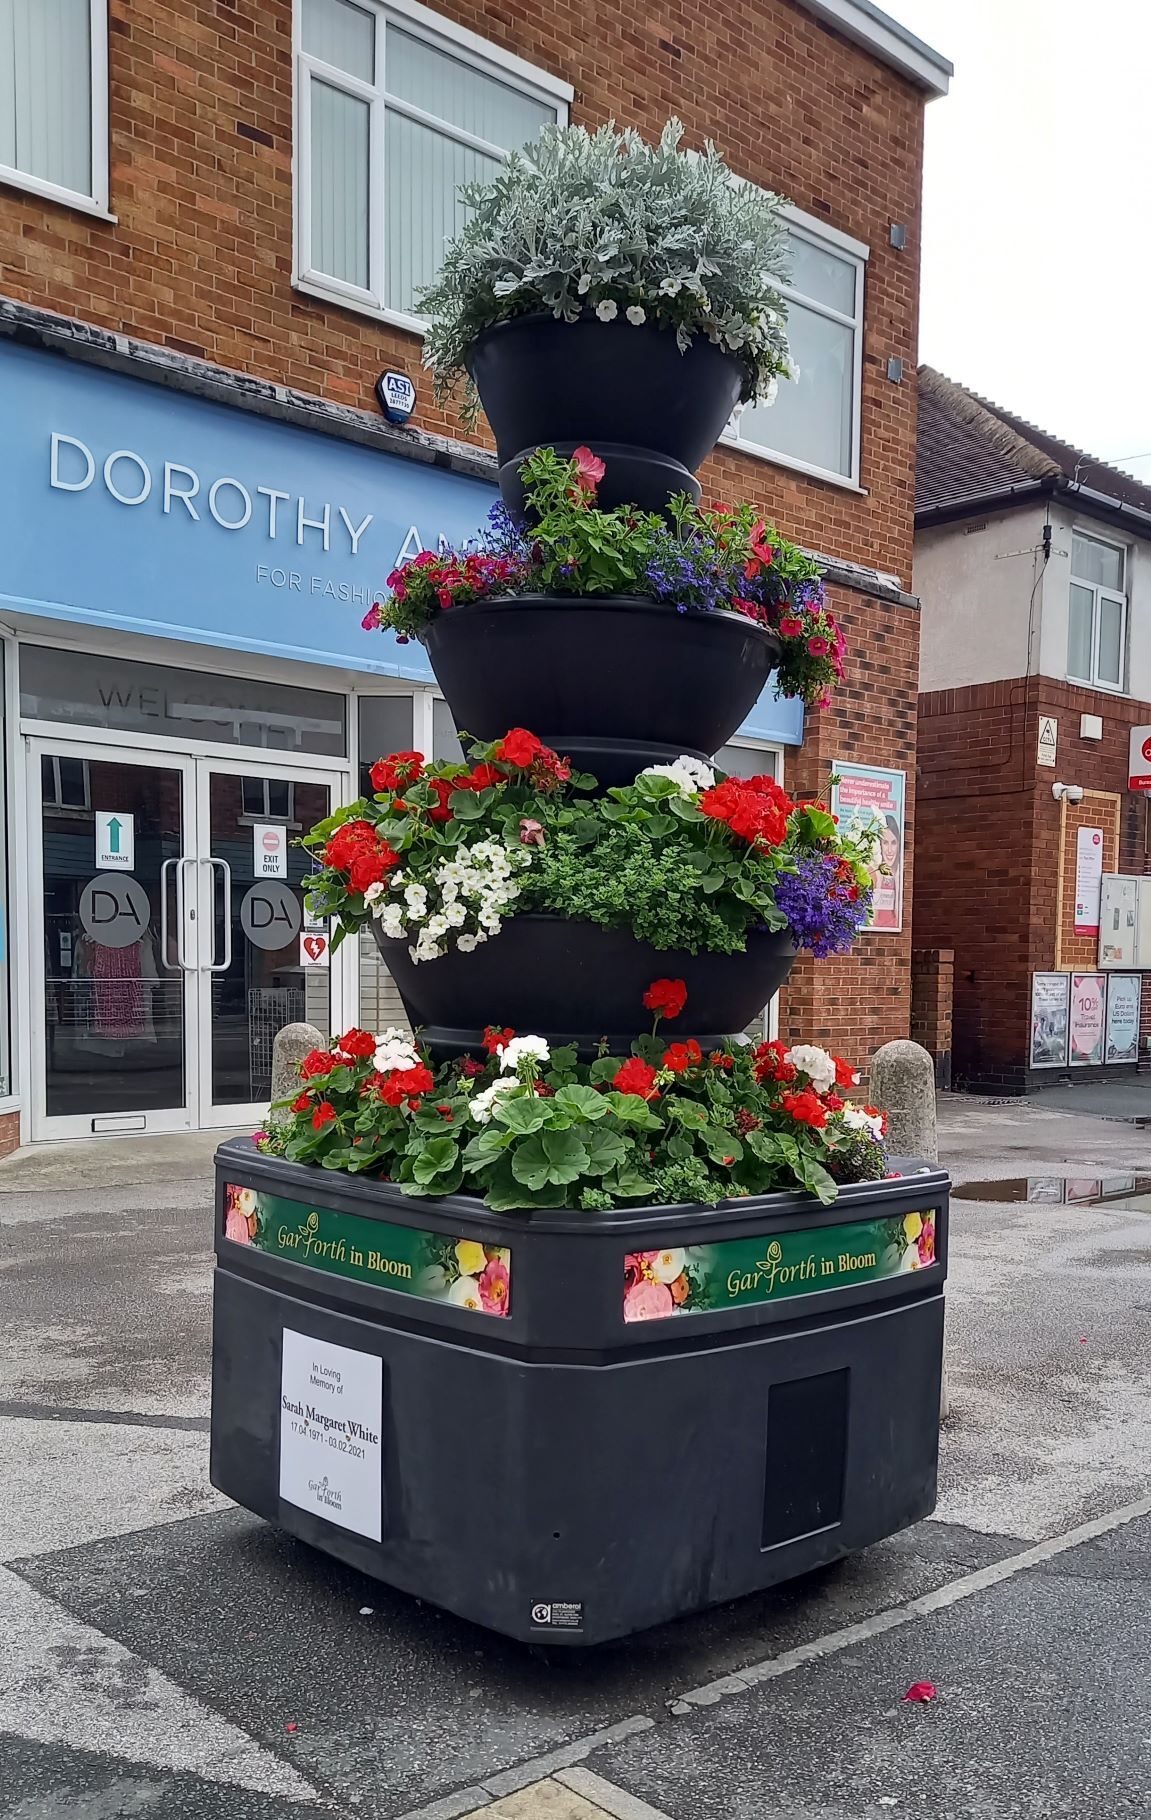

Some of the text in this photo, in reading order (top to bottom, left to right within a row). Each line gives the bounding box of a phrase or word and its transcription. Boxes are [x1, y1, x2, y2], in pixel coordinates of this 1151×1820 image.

[389, 378, 410, 395] ASI
[50, 432, 374, 554] DOROTHY
[256, 564, 386, 605] FOR FASHIO
[101, 854, 129, 863] ENTRANCE
[263, 864, 280, 873] ONLY
[264, 855, 279, 864] EXIT
[277, 1222, 412, 1279] Garforth in Bloom
[727, 1252, 876, 1297] Garforth in Bloom
[312, 1361, 341, 1382] In Loving
[310, 1374, 344, 1394] Memory of
[282, 1395, 379, 1445] Sarah Margaret White
[328, 1436, 366, 1460] 03.02.2021
